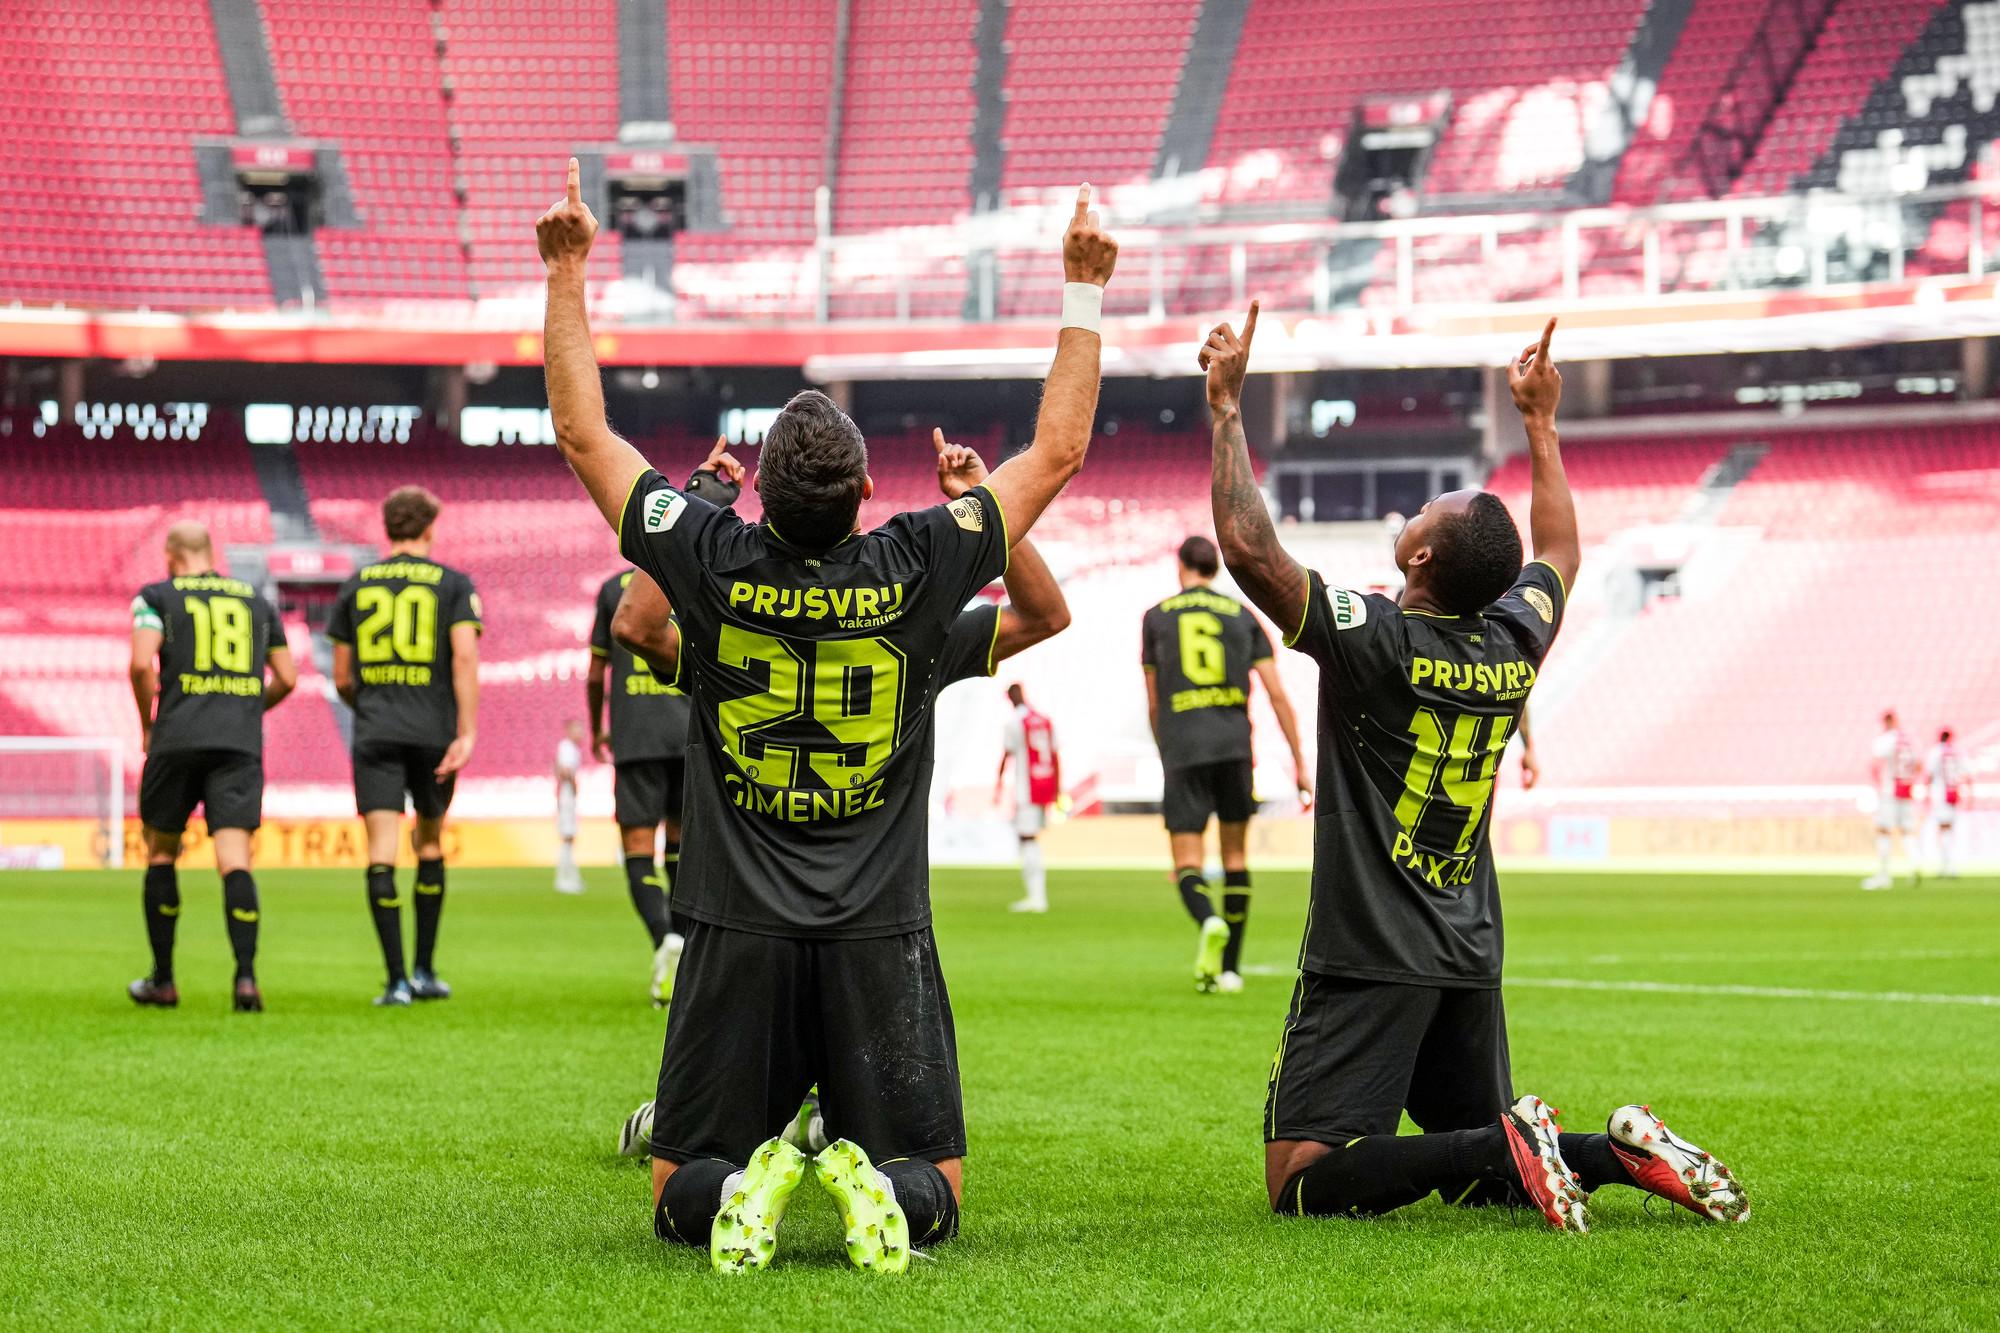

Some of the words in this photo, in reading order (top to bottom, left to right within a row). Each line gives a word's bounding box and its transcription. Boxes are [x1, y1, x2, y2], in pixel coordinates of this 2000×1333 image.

[647, 493, 677, 527] TOTO
[805, 559, 821, 568] 1908
[356, 585, 439, 663] 20
[838, 609, 904, 629] vakanties
[1334, 589, 1352, 624] TOTO
[184, 595, 254, 674] 18
[1178, 611, 1226, 686] 6
[717, 622, 908, 790] 29
[1495, 688, 1528, 701] vakanti
[725, 772, 885, 823] GIMENEZ
[1394, 705, 1514, 854] 14
